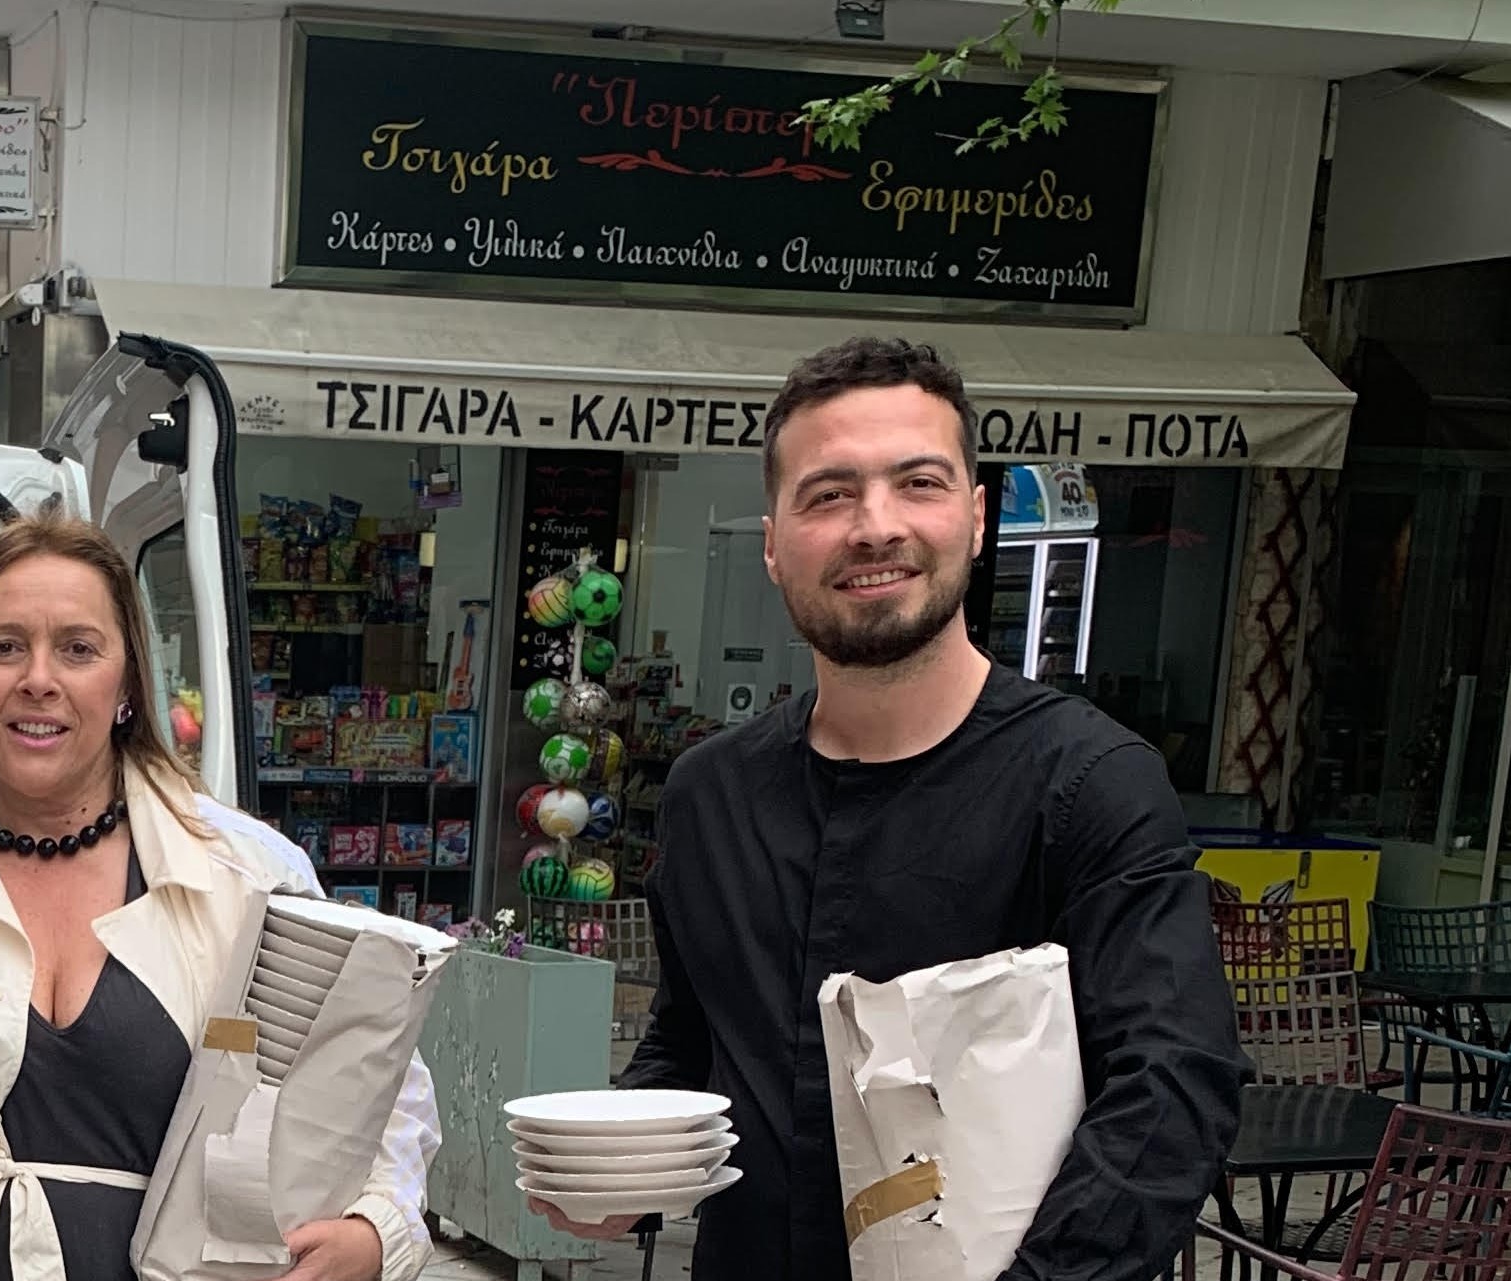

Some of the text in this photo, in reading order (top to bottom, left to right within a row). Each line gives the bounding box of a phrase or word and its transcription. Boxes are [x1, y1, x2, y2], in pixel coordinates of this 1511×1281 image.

[362, 117, 559, 196] Τσιγάρα
[861, 160, 1093, 236] Εφημερίδες
[327, 210, 434, 266] Κάρτες
[597, 225, 742, 268] Παιχνίδια
[317, 381, 521, 437] ΤΣΙΓΑΡΑ
[570, 394, 766, 447] ΚΑΡΤΕΣ
[974, 408, 1081, 456] ΩΔΗ
[1126, 413, 1248, 458] ΠΟΤΑ
